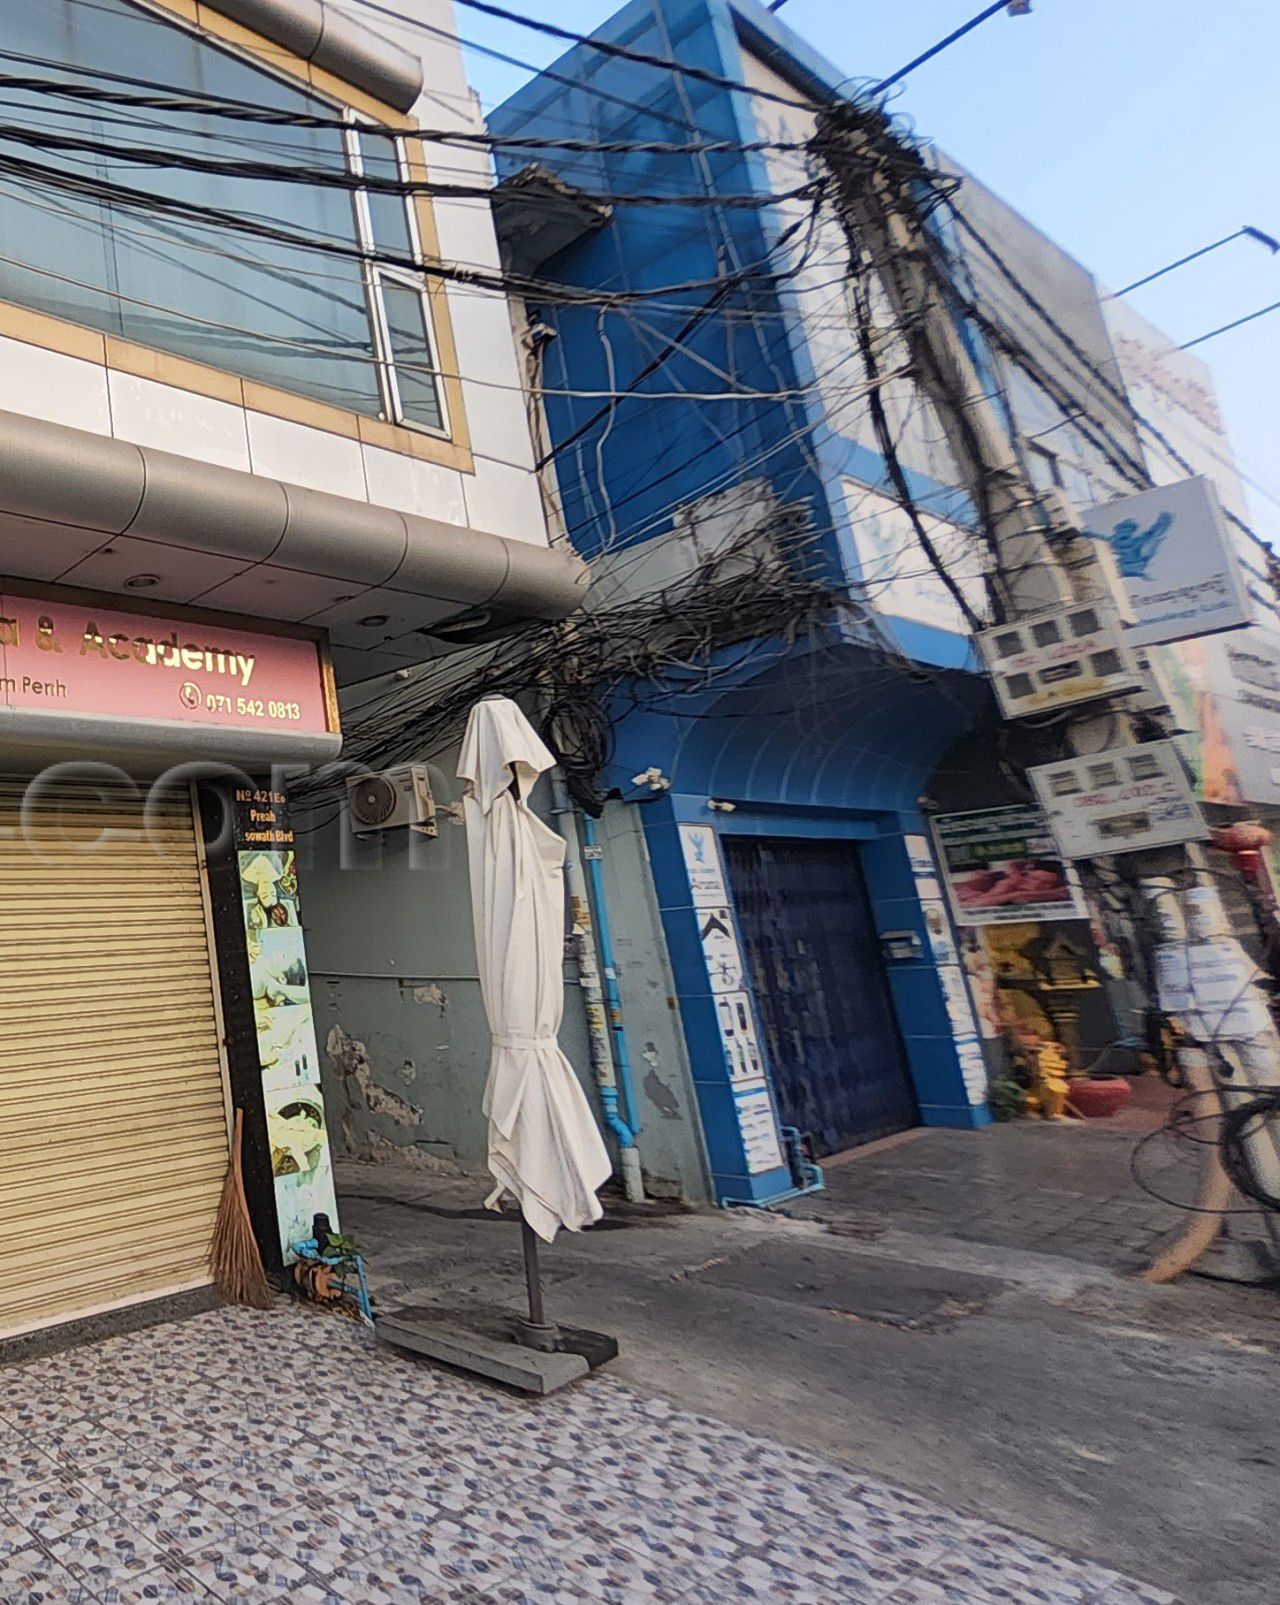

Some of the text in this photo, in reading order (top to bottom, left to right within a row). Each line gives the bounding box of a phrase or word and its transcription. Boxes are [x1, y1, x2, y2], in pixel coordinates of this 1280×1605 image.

[35, 615, 63, 653] &
[79, 620, 256, 686] Academy
[22, 676, 67, 699] Penh
[206, 693, 301, 720] 071 542 0813
[250, 809, 276, 822] Preah
